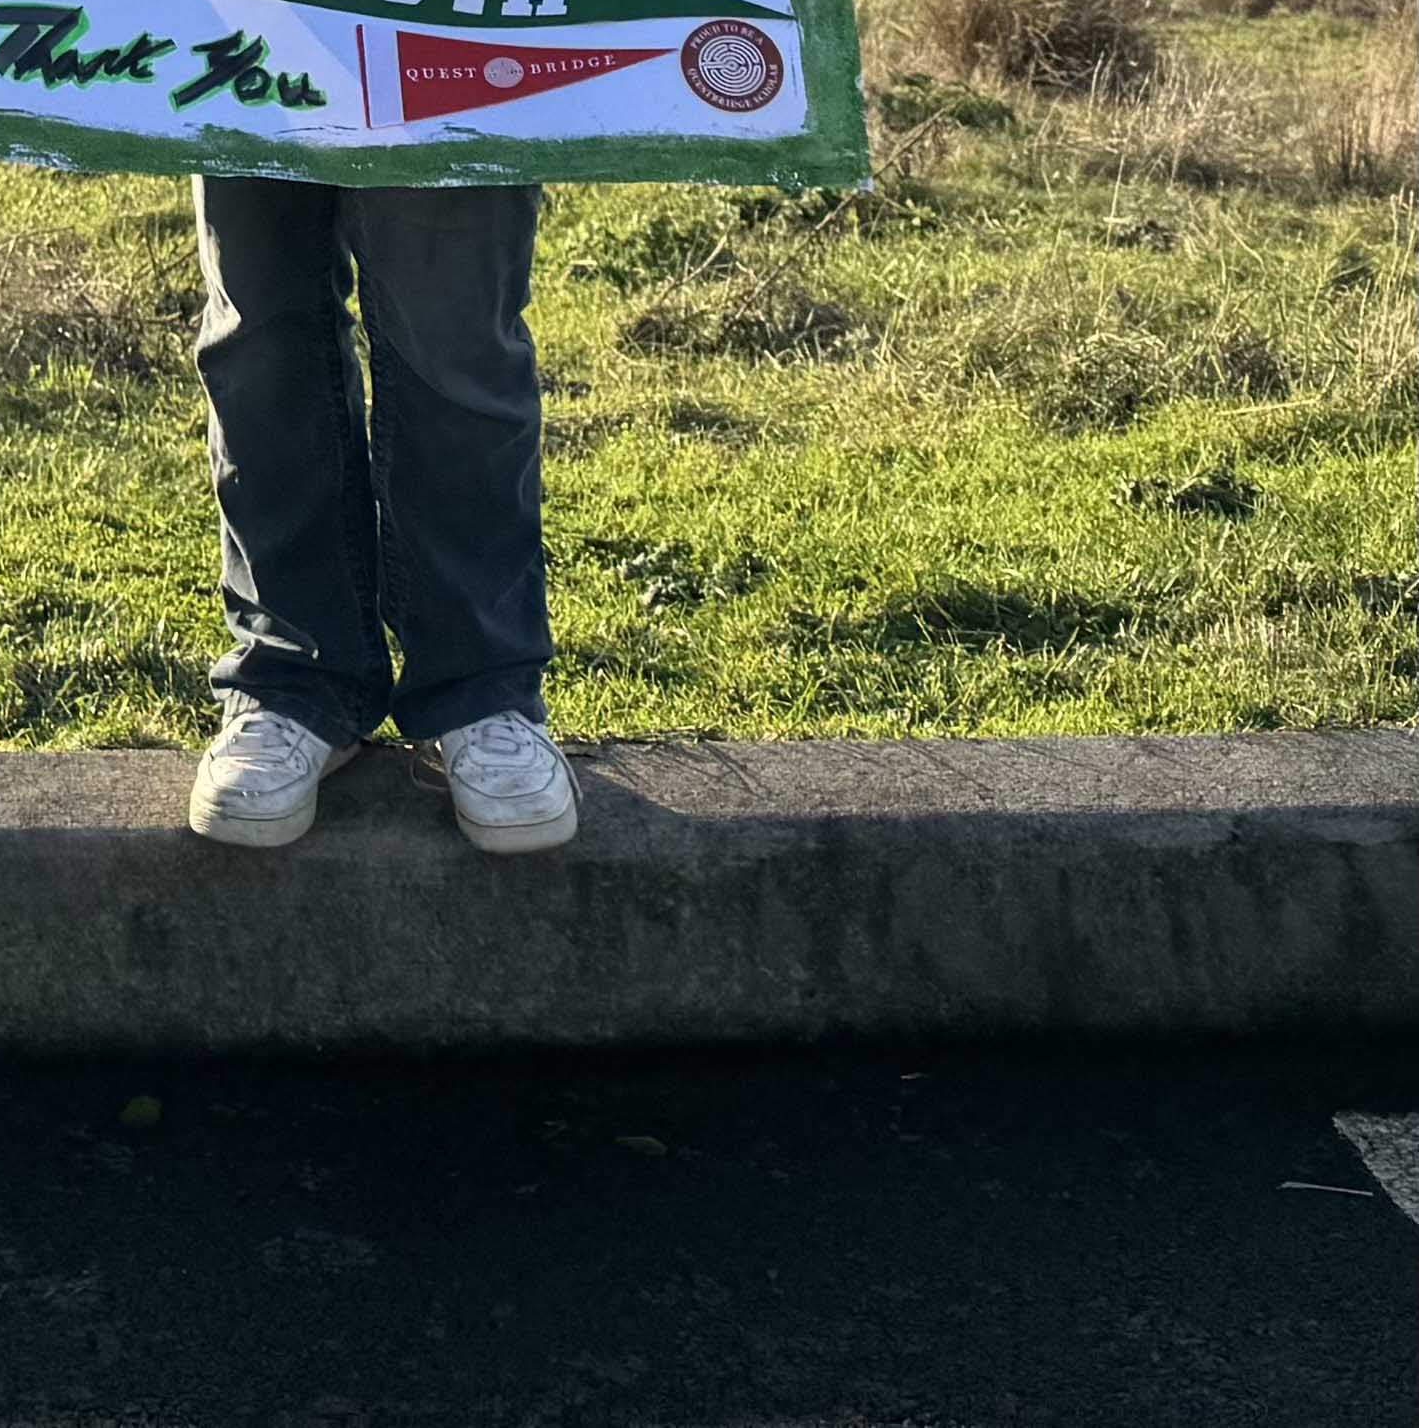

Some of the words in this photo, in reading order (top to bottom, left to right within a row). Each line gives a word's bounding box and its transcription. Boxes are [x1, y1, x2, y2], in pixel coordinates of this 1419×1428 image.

[169, 29, 328, 112] You
[406, 66, 478, 83] QUEST
[530, 54, 617, 76] BRIDGE
